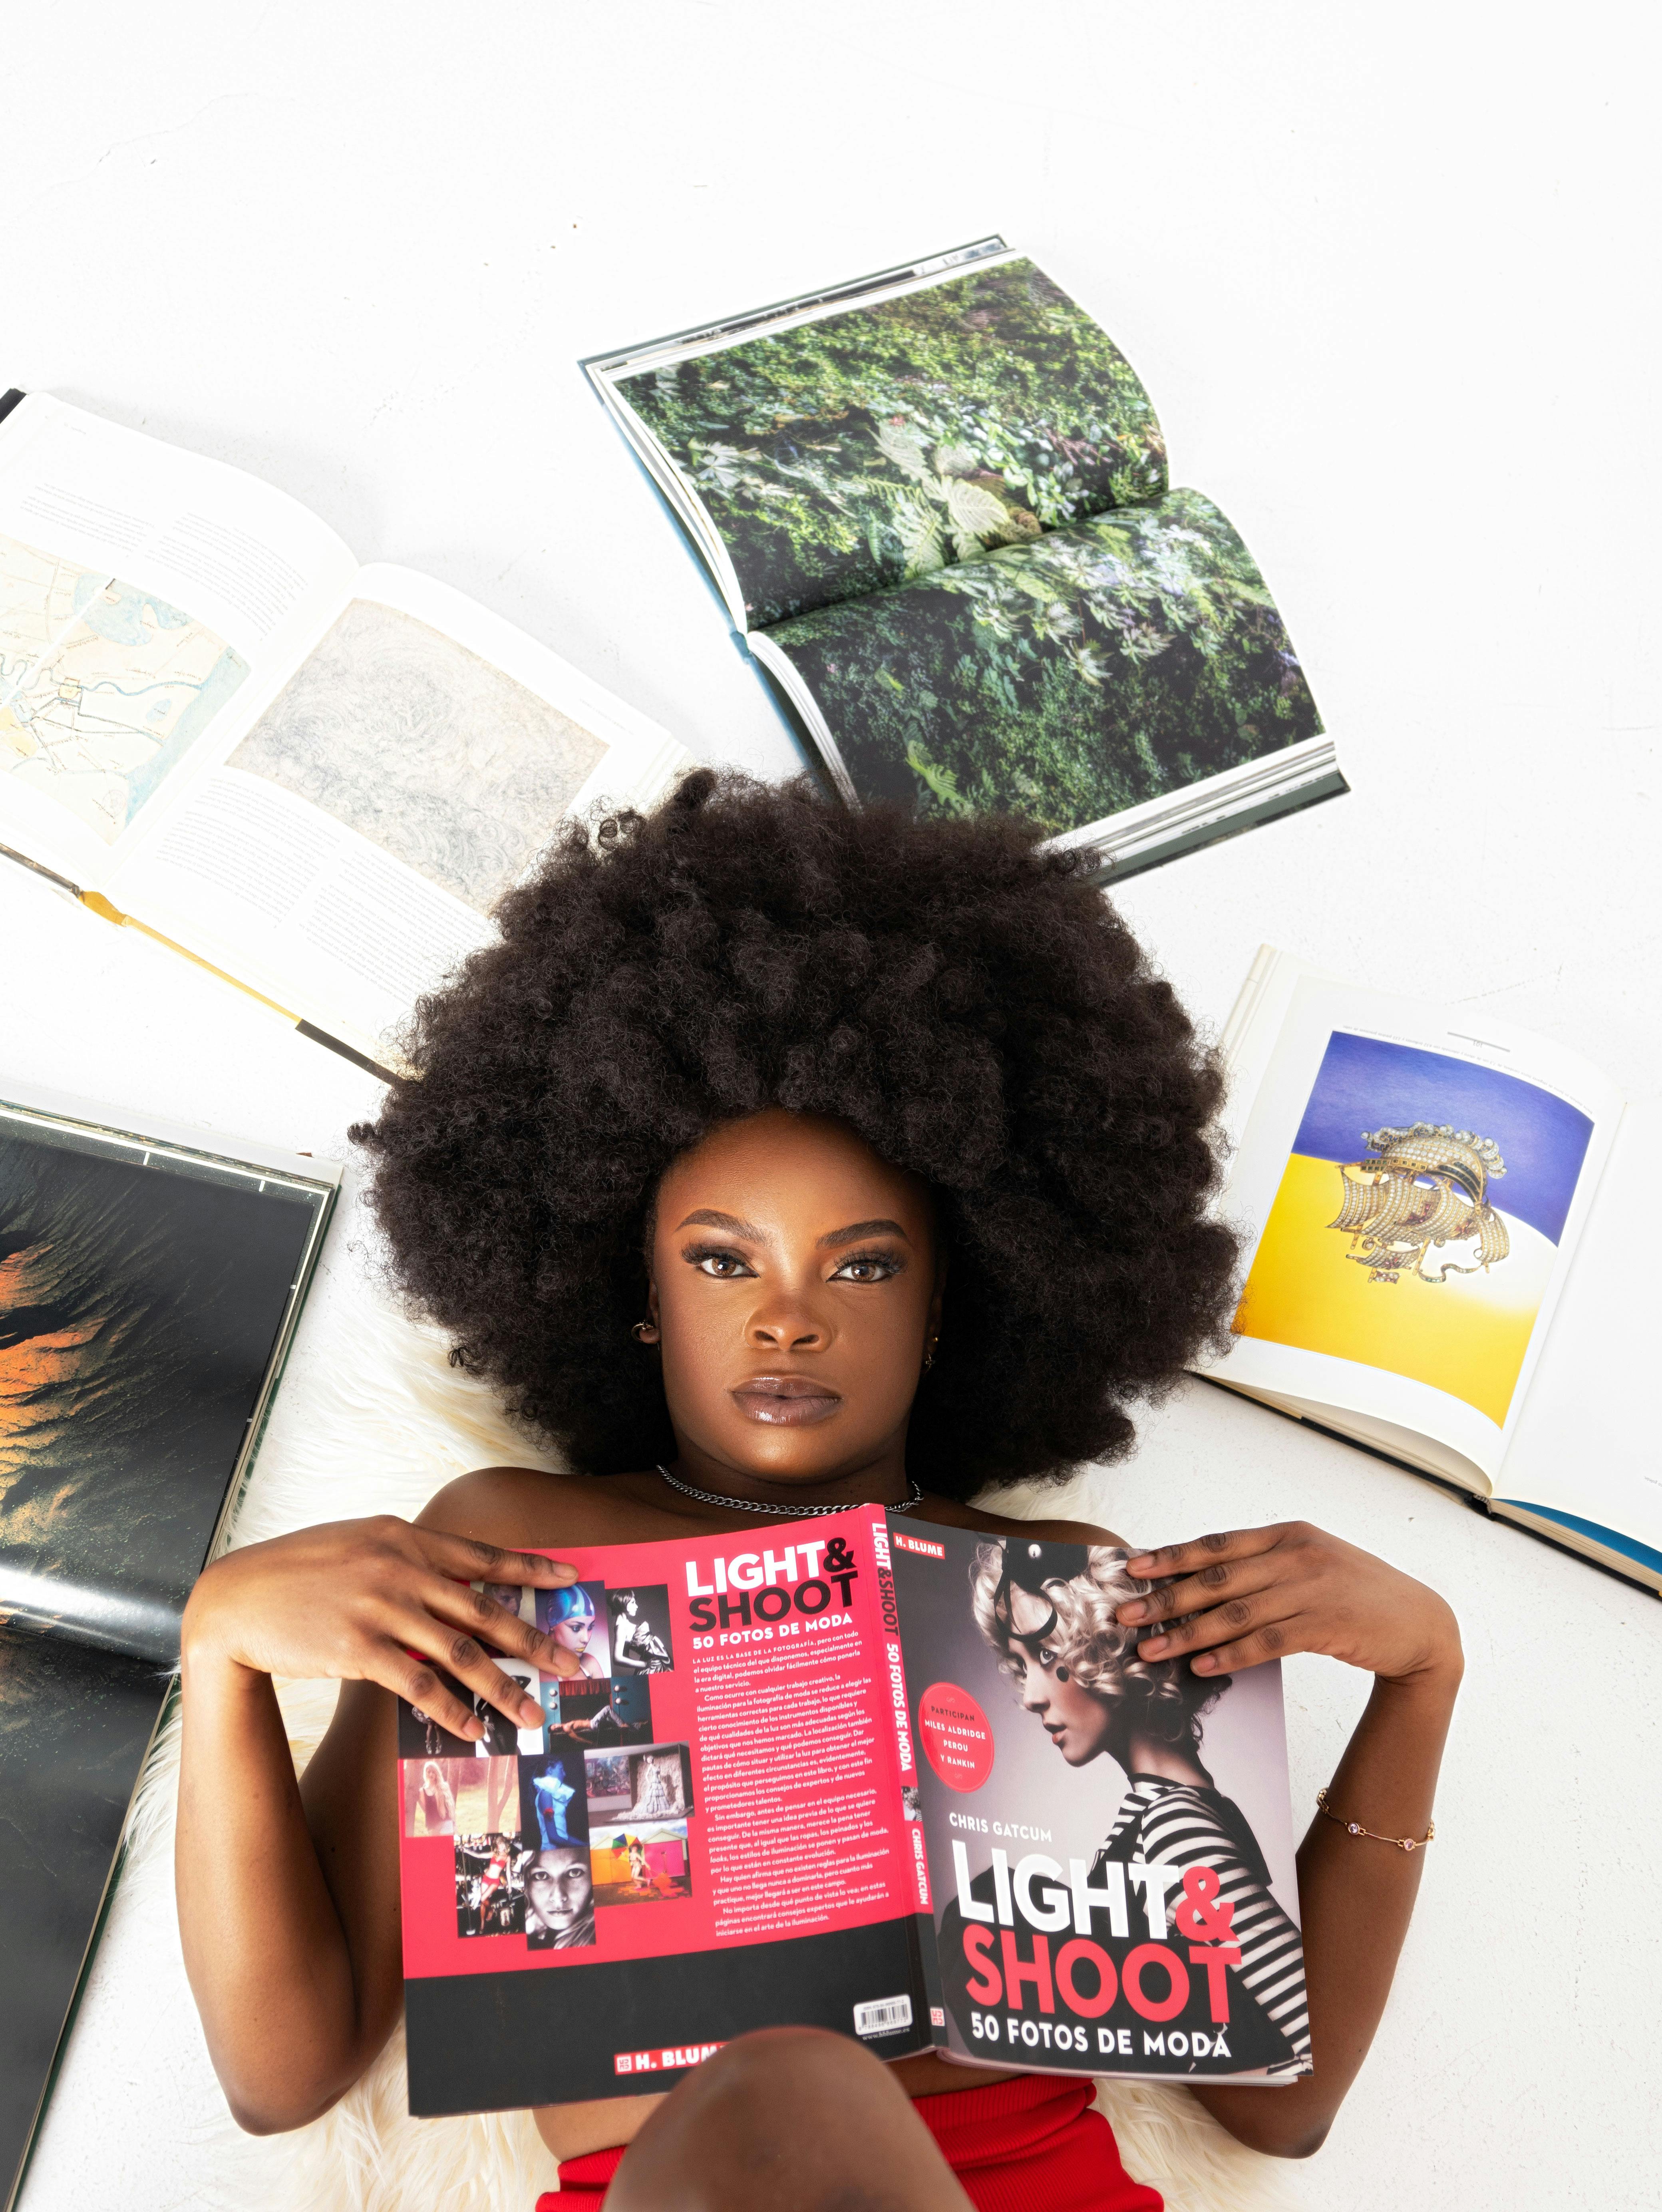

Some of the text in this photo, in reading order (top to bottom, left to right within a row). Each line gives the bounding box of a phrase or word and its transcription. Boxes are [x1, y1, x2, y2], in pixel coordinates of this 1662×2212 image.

[896, 1536, 942, 1556] H. BLUME
[689, 1570, 858, 1632] SHOOT
[693, 1612, 853, 1649] 50 FOTOS DE MODA
[773, 1639, 816, 1652] FOTOGRAFÍA,
[817, 1637, 831, 1646] pero
[844, 1630, 859, 1639] todo
[700, 1665, 722, 1673] equipo
[723, 1661, 746, 1670] técnico
[771, 1651, 809, 1663] disponemos,
[810, 1642, 854, 1656] especialmente
[712, 1672, 734, 1682] digital,
[734, 1669, 763, 1679] podemos
[764, 1664, 785, 1673] olvidar
[786, 1659, 819, 1669] fácilmente
[837, 1649, 861, 1661] ponerla
[887, 1643, 899, 1662] 50
[696, 1702, 732, 1712] iluminación
[753, 1694, 784, 1705] fotografía
[793, 1689, 811, 1698] moda
[819, 1685, 840, 1693] reduce
[845, 1679, 862, 1688] elegir
[725, 1680, 751, 1689] servicio.
[757, 1685, 785, 1694] cualquier
[786, 1680, 808, 1689] trabajo
[809, 1676, 835, 1685] creativo,
[889, 1664, 905, 1708] FOTOS
[697, 1712, 738, 1722] herramientas
[739, 1708, 768, 1717] correctas
[769, 1705, 783, 1714] para
[783, 1701, 798, 1710] cada
[798, 1698, 822, 1707] trabajo,
[841, 1689, 867, 1699] requiere
[718, 1719, 759, 1730] conocimiento
[779, 1709, 819, 1721] instrumentos
[819, 1701, 853, 1713] disponibles
[895, 1710, 908, 1729] DE
[931, 1706, 974, 1721] PARTICIPAN
[700, 1743, 729, 1752] objetivos
[775, 1731, 803, 1741] marcado.
[812, 1722, 847, 1735] localización
[847, 1717, 872, 1727] también
[708, 1733, 720, 1742] qué
[721, 1729, 754, 1739] cualidades
[791, 1720, 804, 1729] más
[805, 1715, 837, 1726] adecuadas
[837, 1710, 856, 1720] según
[925, 1719, 986, 1740] MILES ALDRIDGE
[701, 1752, 723, 1762] dictará
[723, 1751, 736, 1760] qué
[736, 1747, 775, 1757] necesitamos
[780, 1742, 792, 1752] qué
[793, 1739, 821, 1750] podemos
[822, 1731, 853, 1743] conseguir.
[897, 1731, 913, 1771] MODA
[943, 1739, 968, 1752] PEROU
[940, 1754, 975, 1769] Y RANKIN
[949, 1812, 1052, 1842] CHRIS GATCUM
[912, 1828, 929, 1905] CHRIS GATCUM
[963, 1924, 1242, 2023] SHOOT
[971, 2012, 1232, 2058] 50 FOTOS DE MODA
[635, 2045, 724, 2070] H. BLUM
